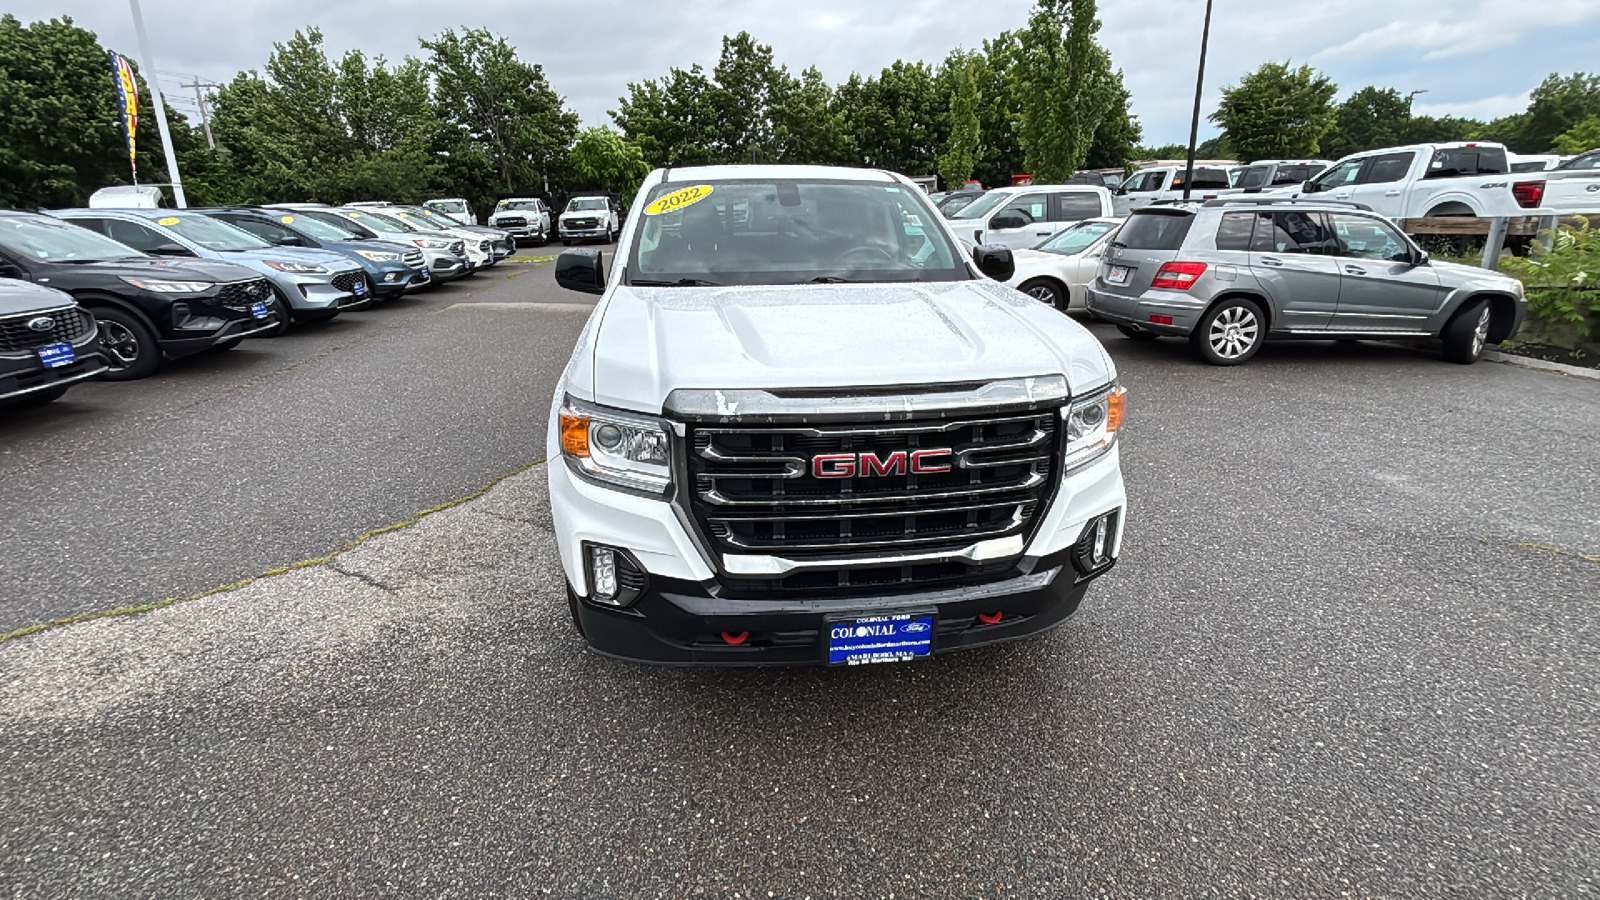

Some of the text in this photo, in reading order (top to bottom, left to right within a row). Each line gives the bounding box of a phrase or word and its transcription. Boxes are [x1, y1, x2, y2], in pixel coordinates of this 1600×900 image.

[657, 187, 702, 212] 2022
[812, 448, 952, 479] GMC
[856, 616, 890, 624] COLONIAL
[831, 624, 897, 639] COLONIAL
